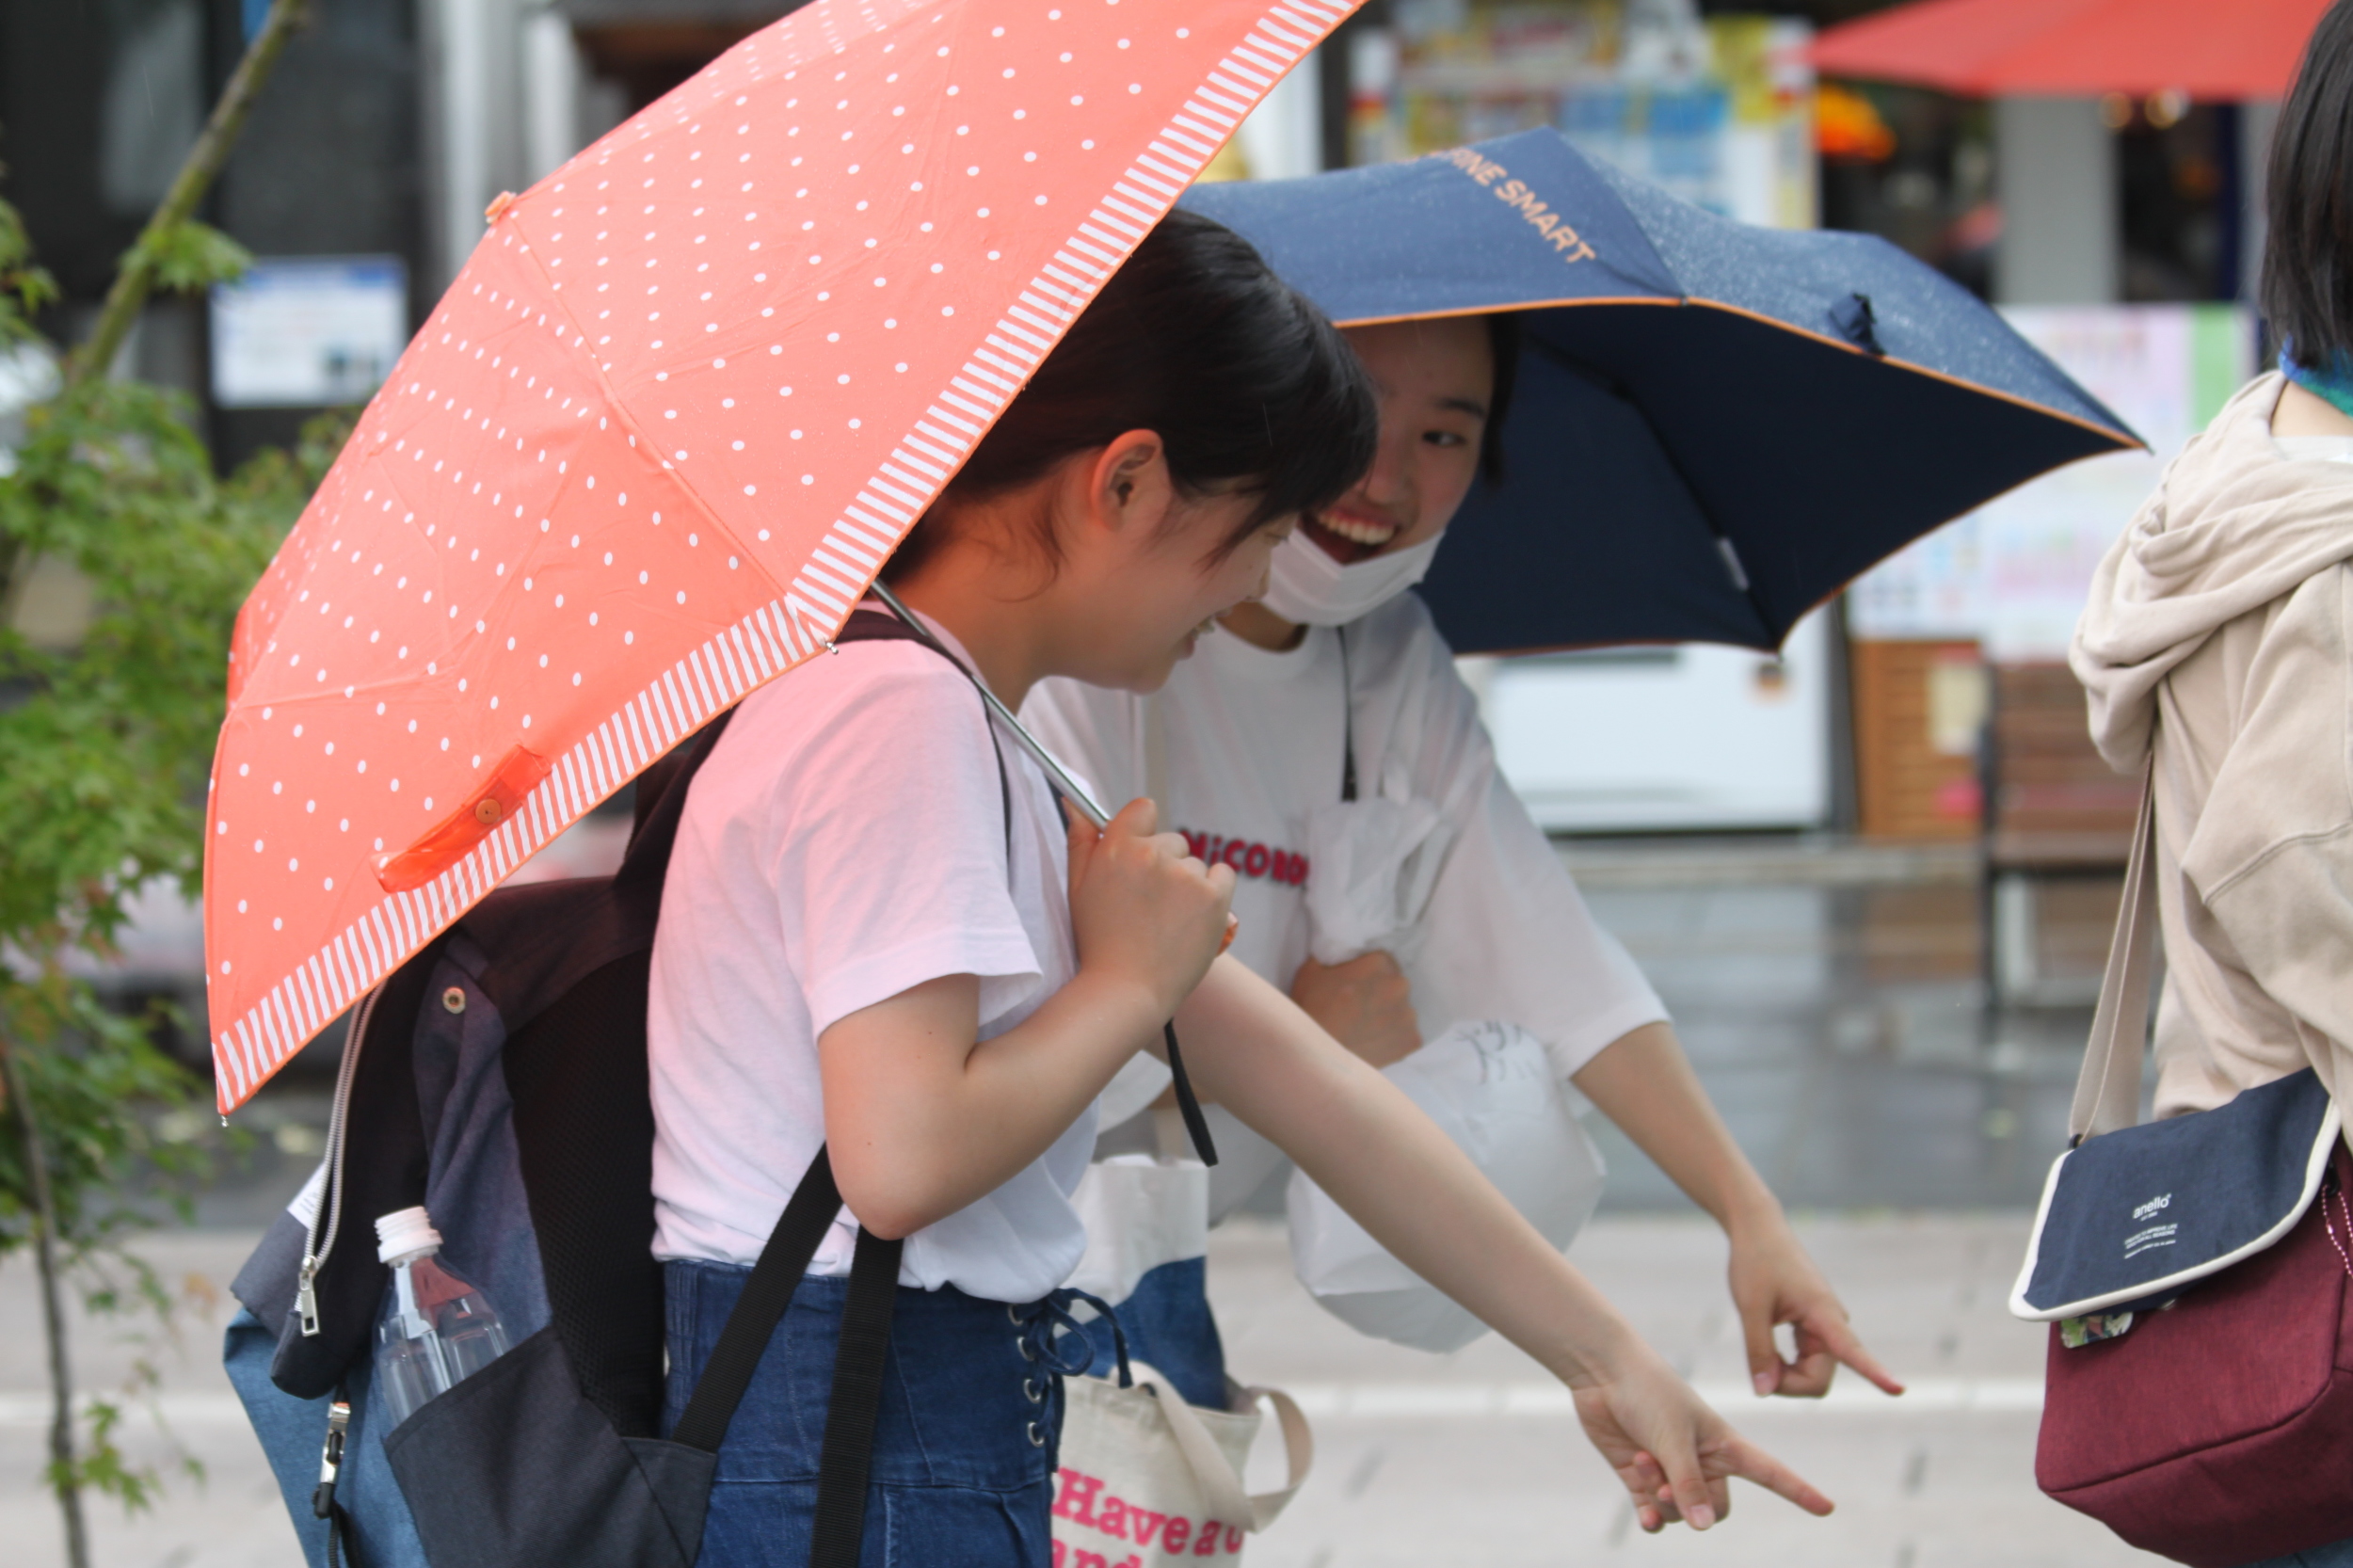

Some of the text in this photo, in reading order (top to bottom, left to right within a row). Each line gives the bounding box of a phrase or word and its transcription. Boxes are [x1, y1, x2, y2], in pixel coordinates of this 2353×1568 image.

[1495, 180, 1596, 263] SMART
[2133, 1195, 2169, 1219] anello
[1051, 1467, 1191, 1556] Have
